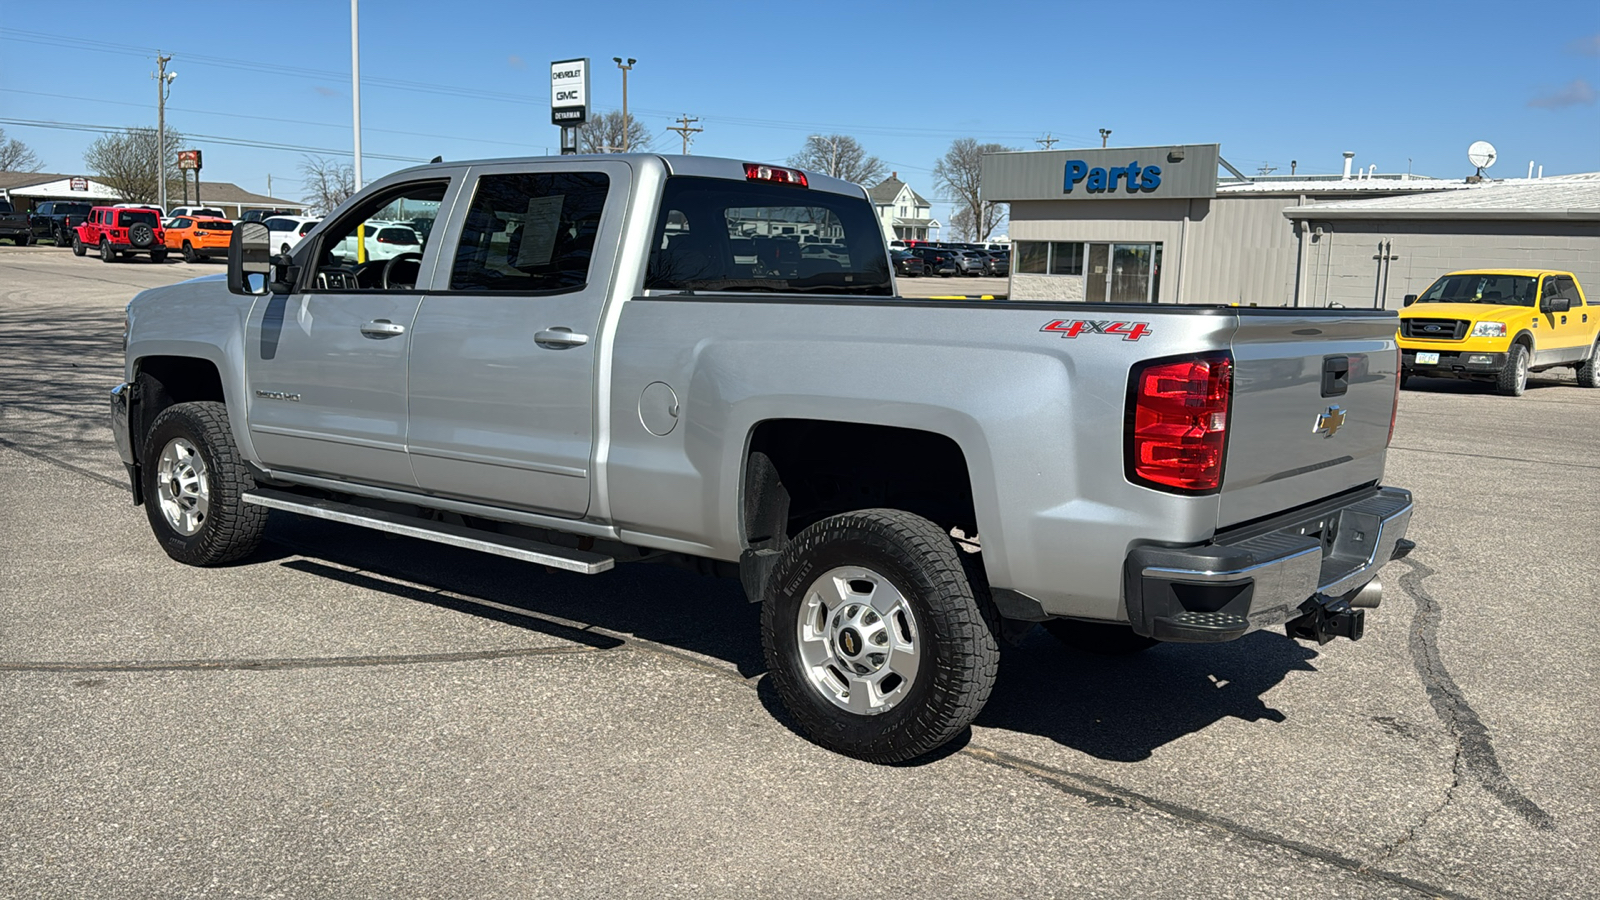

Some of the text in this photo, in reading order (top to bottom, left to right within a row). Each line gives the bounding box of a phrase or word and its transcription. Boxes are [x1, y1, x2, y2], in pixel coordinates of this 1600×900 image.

[552, 70, 581, 80] CHEVROLET
[556, 90, 578, 101] GMC
[554, 111, 580, 120] DEYARMAN
[1063, 159, 1162, 194] Parts
[783, 559, 813, 597] PIRELLI
